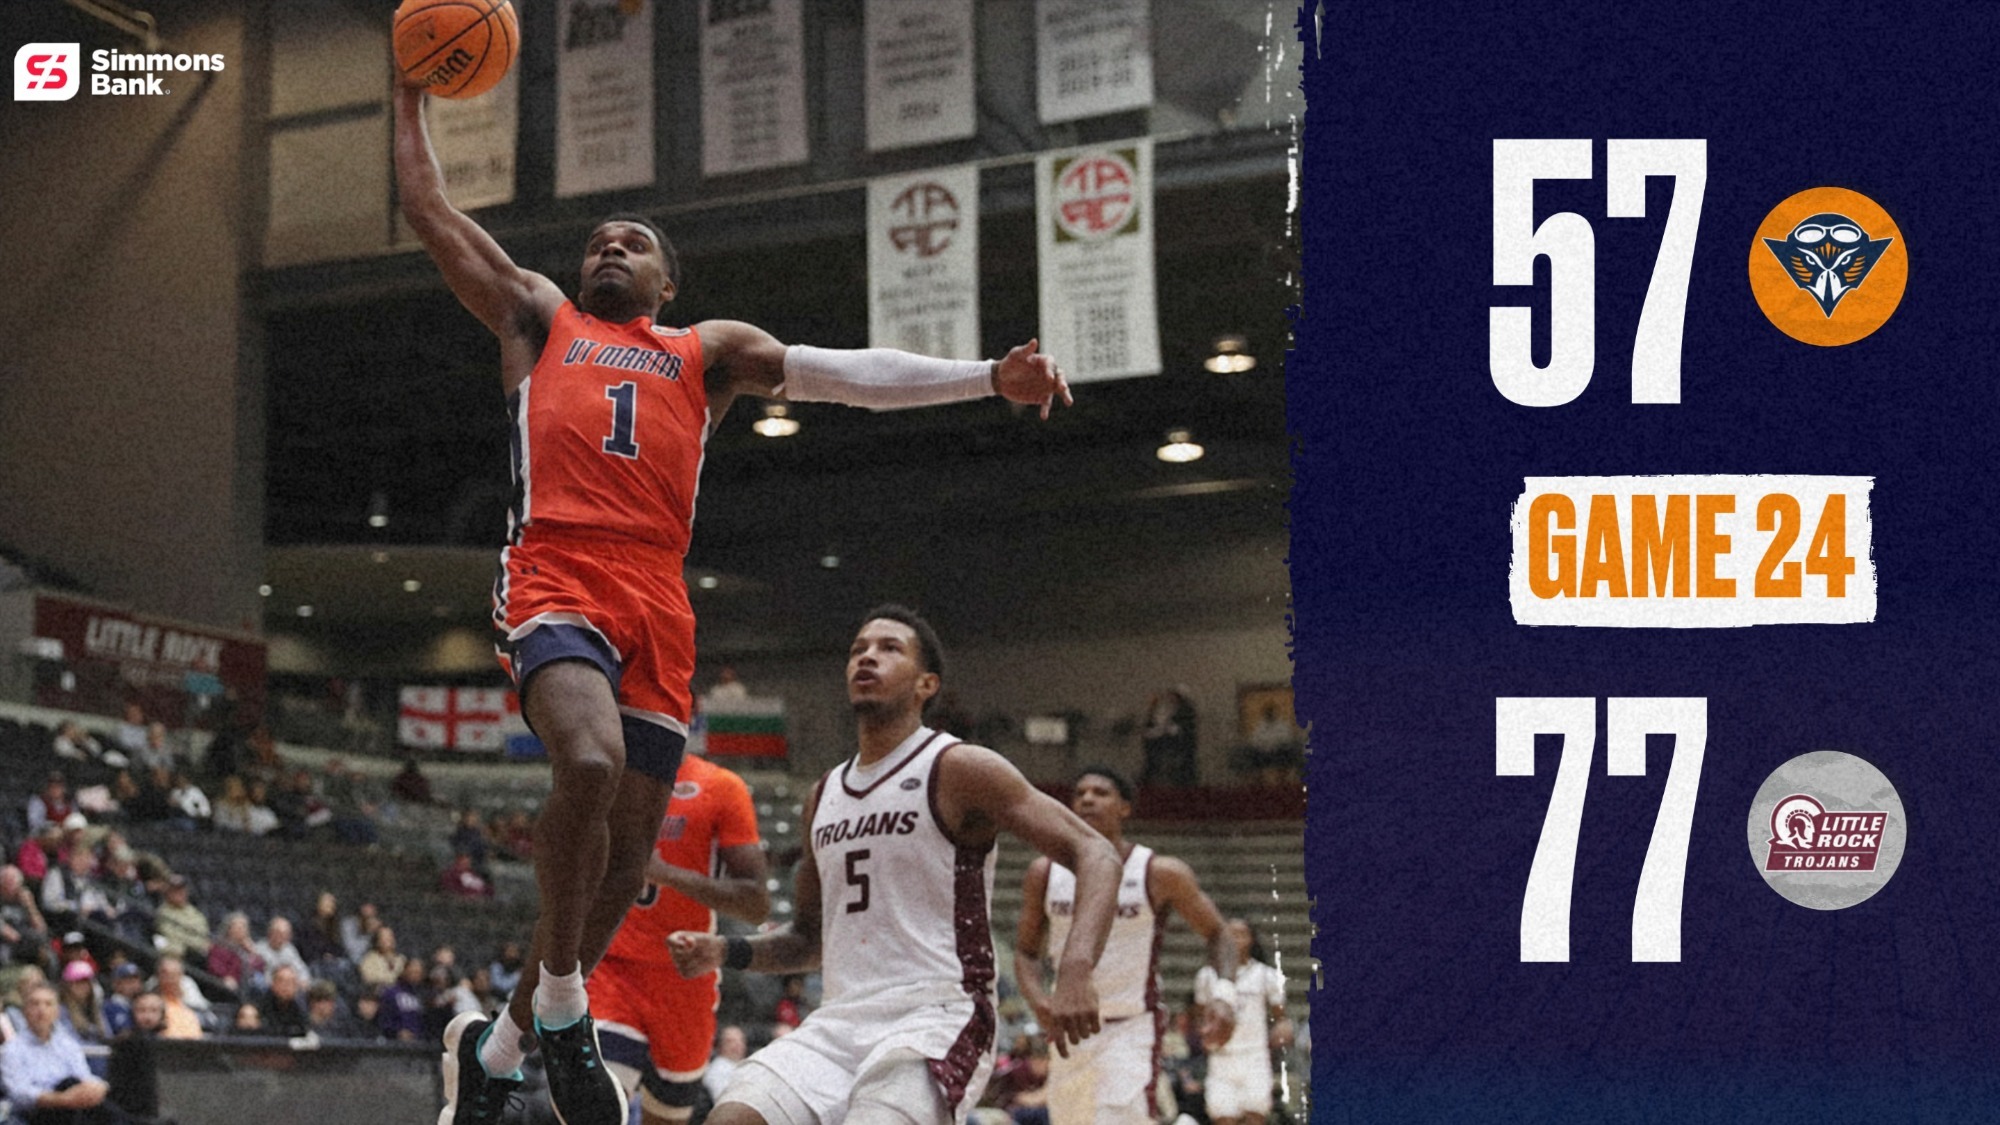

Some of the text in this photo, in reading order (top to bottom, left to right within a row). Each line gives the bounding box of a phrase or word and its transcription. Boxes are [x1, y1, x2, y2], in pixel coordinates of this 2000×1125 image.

[563, 338, 600, 366] UT
[602, 380, 639, 460] 1
[815, 811, 919, 850] TROJANS
[845, 849, 871, 914] 5
